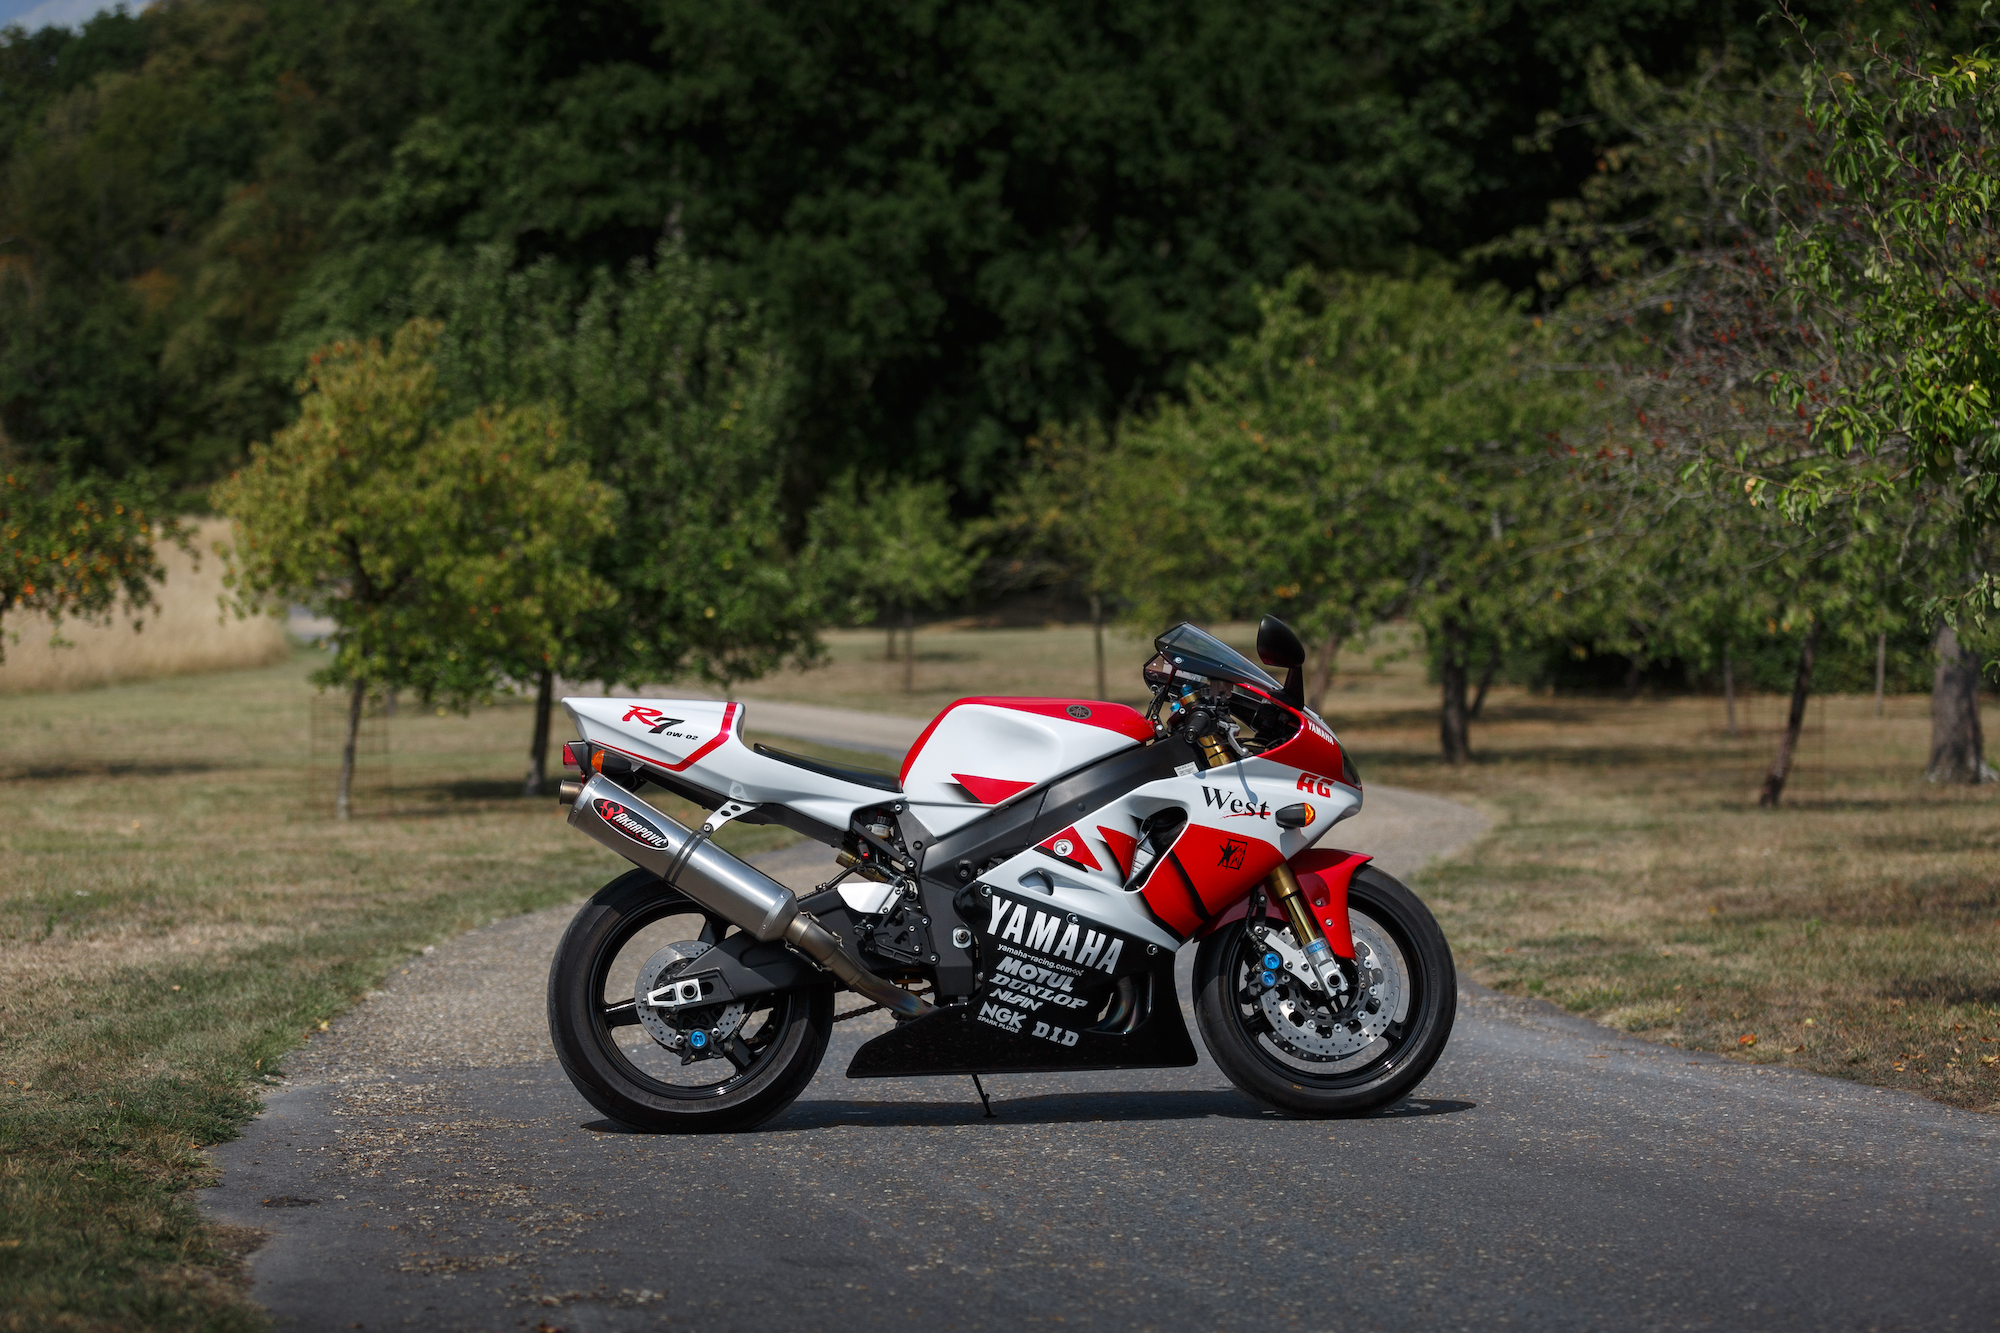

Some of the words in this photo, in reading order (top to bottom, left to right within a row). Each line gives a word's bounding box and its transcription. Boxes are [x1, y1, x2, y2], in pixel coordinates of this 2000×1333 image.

[622, 705, 685, 734] R7
[1307, 720, 1334, 745] YAMAHA
[1201, 785, 1268, 820] West
[987, 895, 1124, 975] YAMAHA
[996, 956, 1075, 992] MOTUL
[989, 973, 1088, 1009] DUNLOP
[979, 1001, 1027, 1029] NGK
[1032, 1021, 1079, 1047] D.I.D
